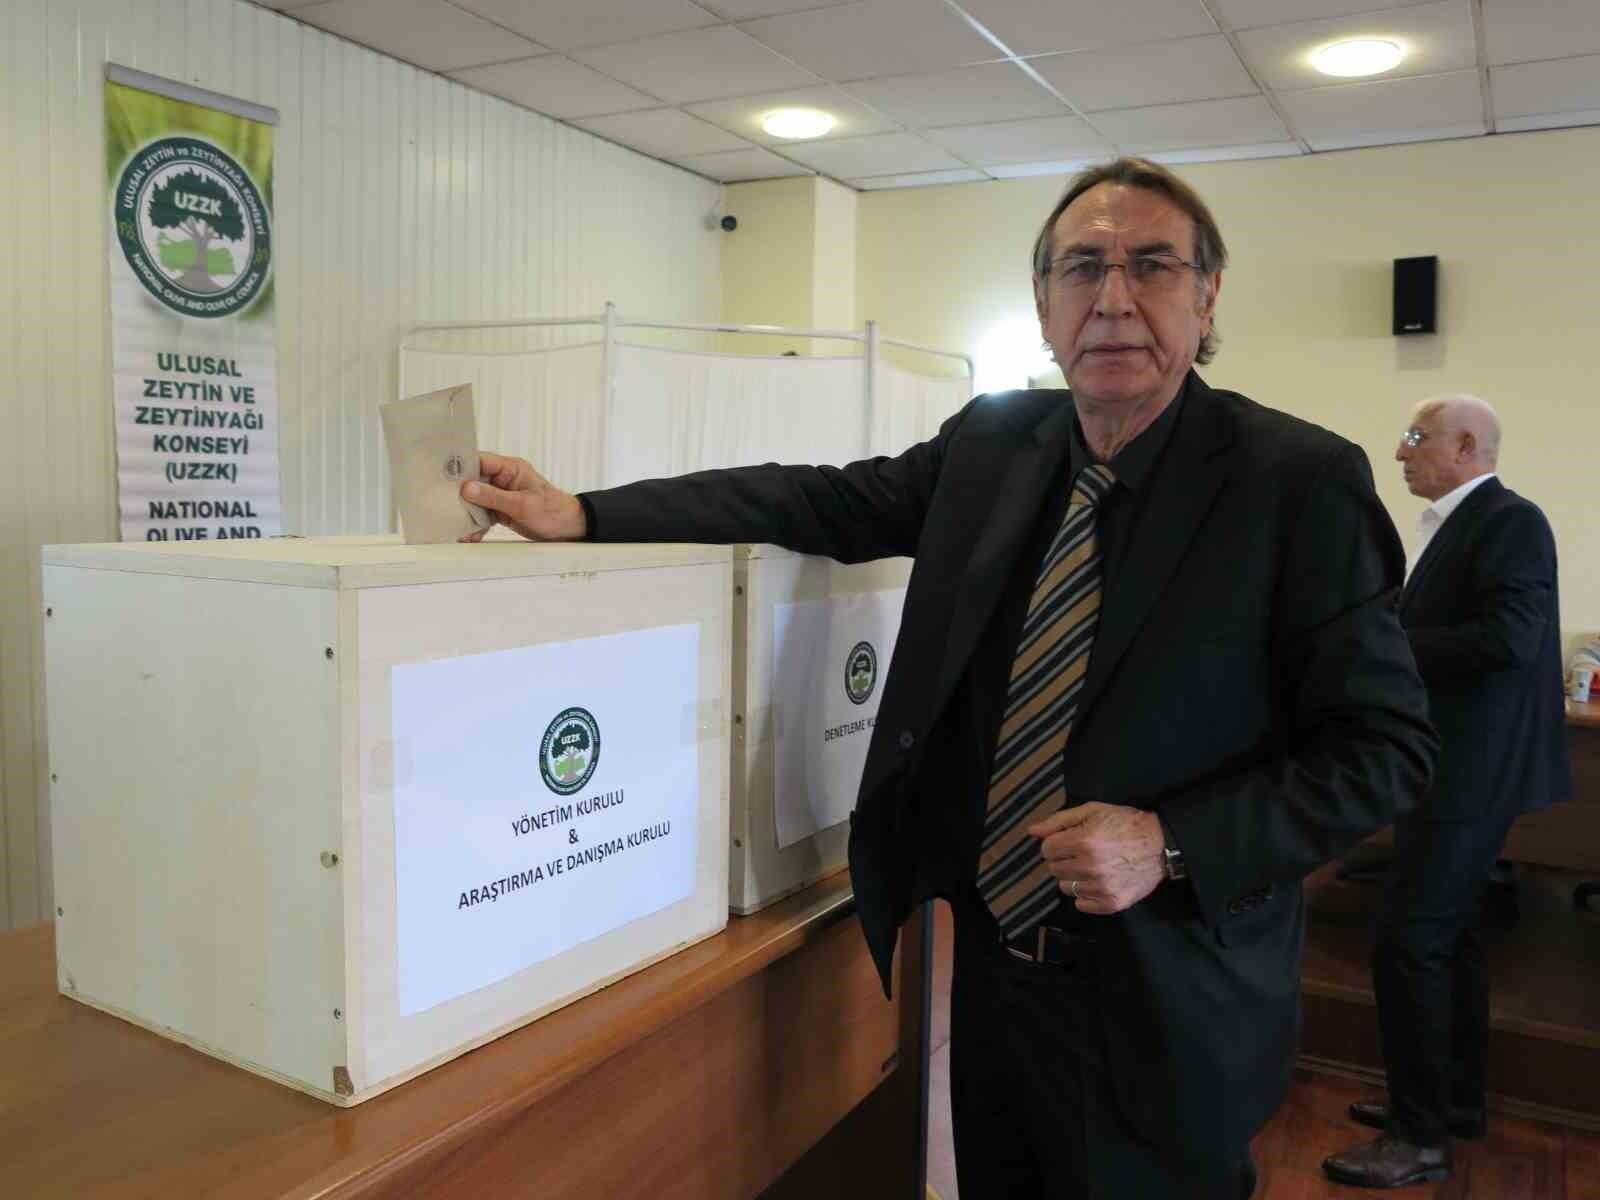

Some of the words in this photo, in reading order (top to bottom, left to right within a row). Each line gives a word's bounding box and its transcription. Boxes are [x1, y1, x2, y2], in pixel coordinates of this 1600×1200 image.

[123, 168, 146, 209] ULUSAL
[174, 191, 222, 217] UZZK
[157, 352, 242, 377] ULUSAL
[143, 379, 223, 402] ZEYTİN
[230, 386, 256, 404] VE
[135, 405, 264, 430] ZEYTİNYAĞI
[153, 434, 249, 455] KONSEYİ
[165, 462, 238, 483] (UZZK)
[149, 500, 257, 519] NATIONAL
[146, 527, 208, 542] OLIVE
[216, 526, 261, 540] AND
[560, 733, 581, 745] UZZK
[824, 719, 865, 742] DENETLEME
[511, 805, 573, 836] YÖNETİM
[576, 789, 625, 817] KURULU
[568, 828, 579, 844] &
[458, 866, 545, 910] ARAŞTIRMA
[547, 858, 563, 878] VE
[567, 838, 624, 871] DANIŞMA
[627, 821, 671, 849] KURULU
